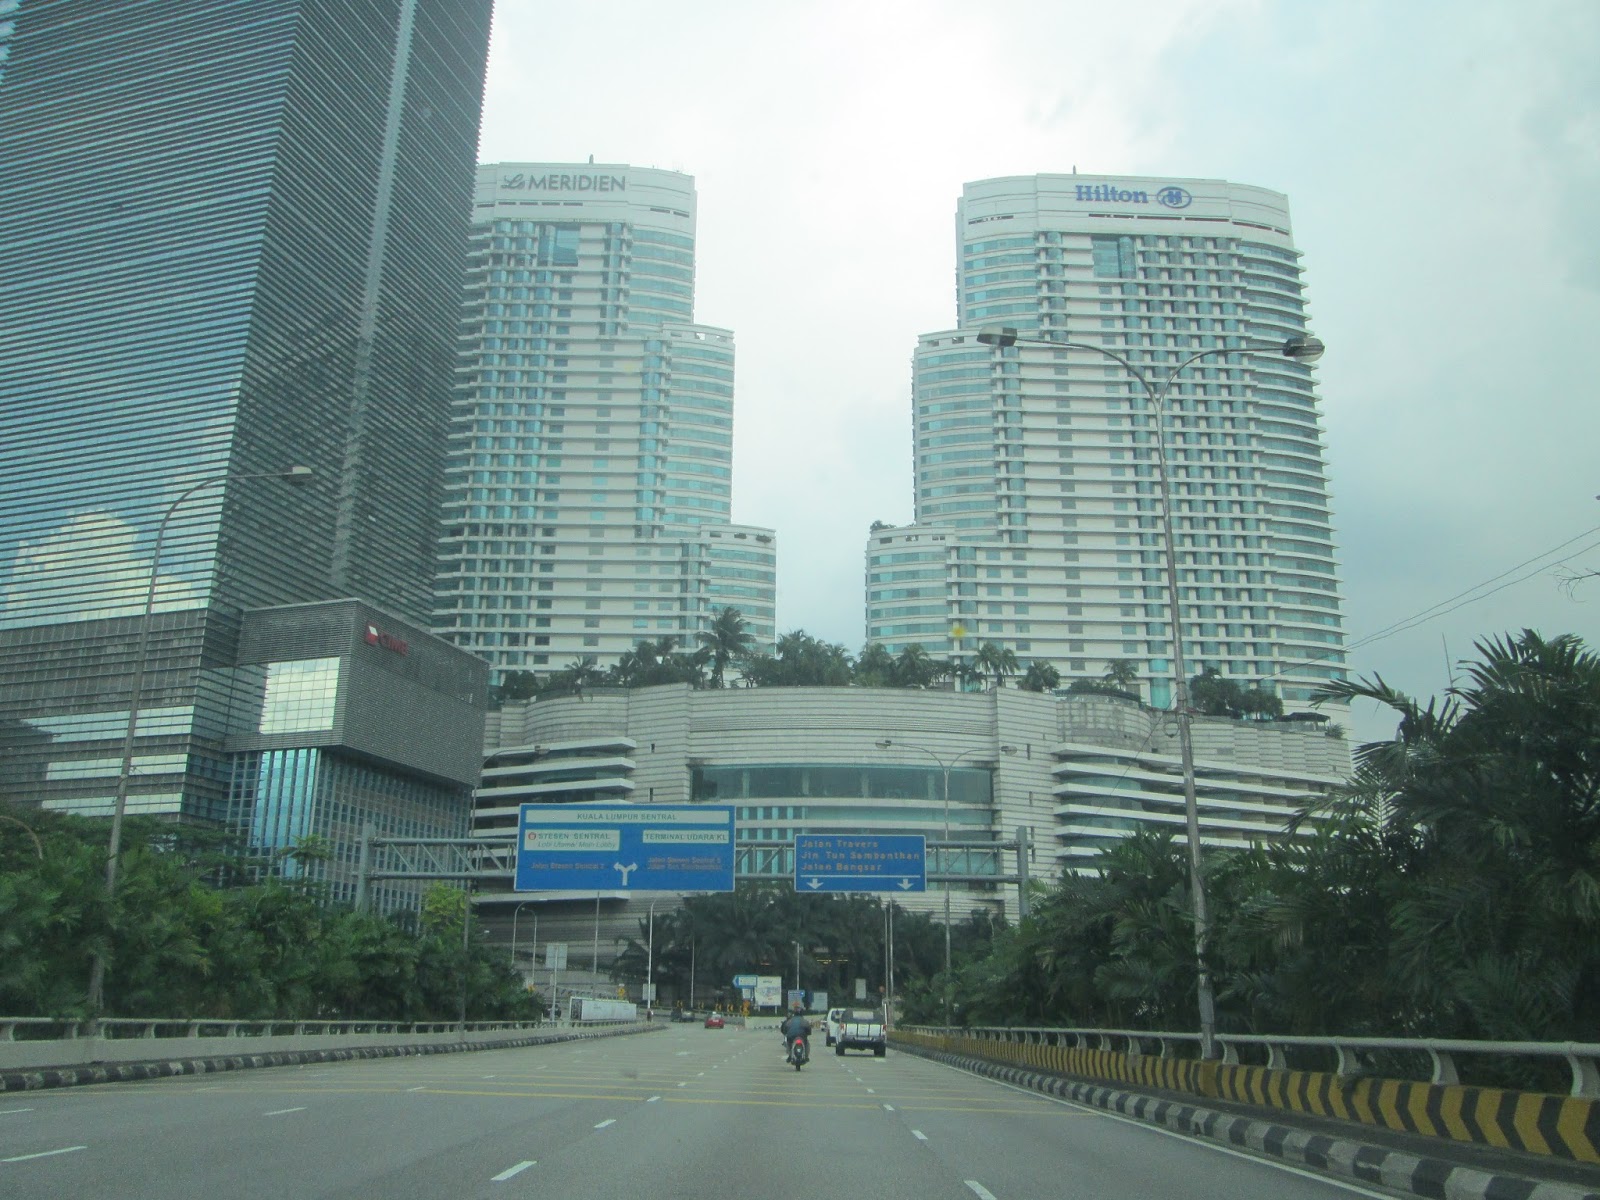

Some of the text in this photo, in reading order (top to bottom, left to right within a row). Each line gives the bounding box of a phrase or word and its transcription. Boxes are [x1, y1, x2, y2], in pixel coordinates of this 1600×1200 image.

[501, 173, 626, 192] Le MERIDIEN
[1075, 184, 1149, 204] Hilton
[641, 813, 677, 821] SENTRAL
[802, 840, 879, 848] Jalan Travers
[826, 851, 846, 859] Tun
[802, 863, 882, 872] Jalan Bangsar
